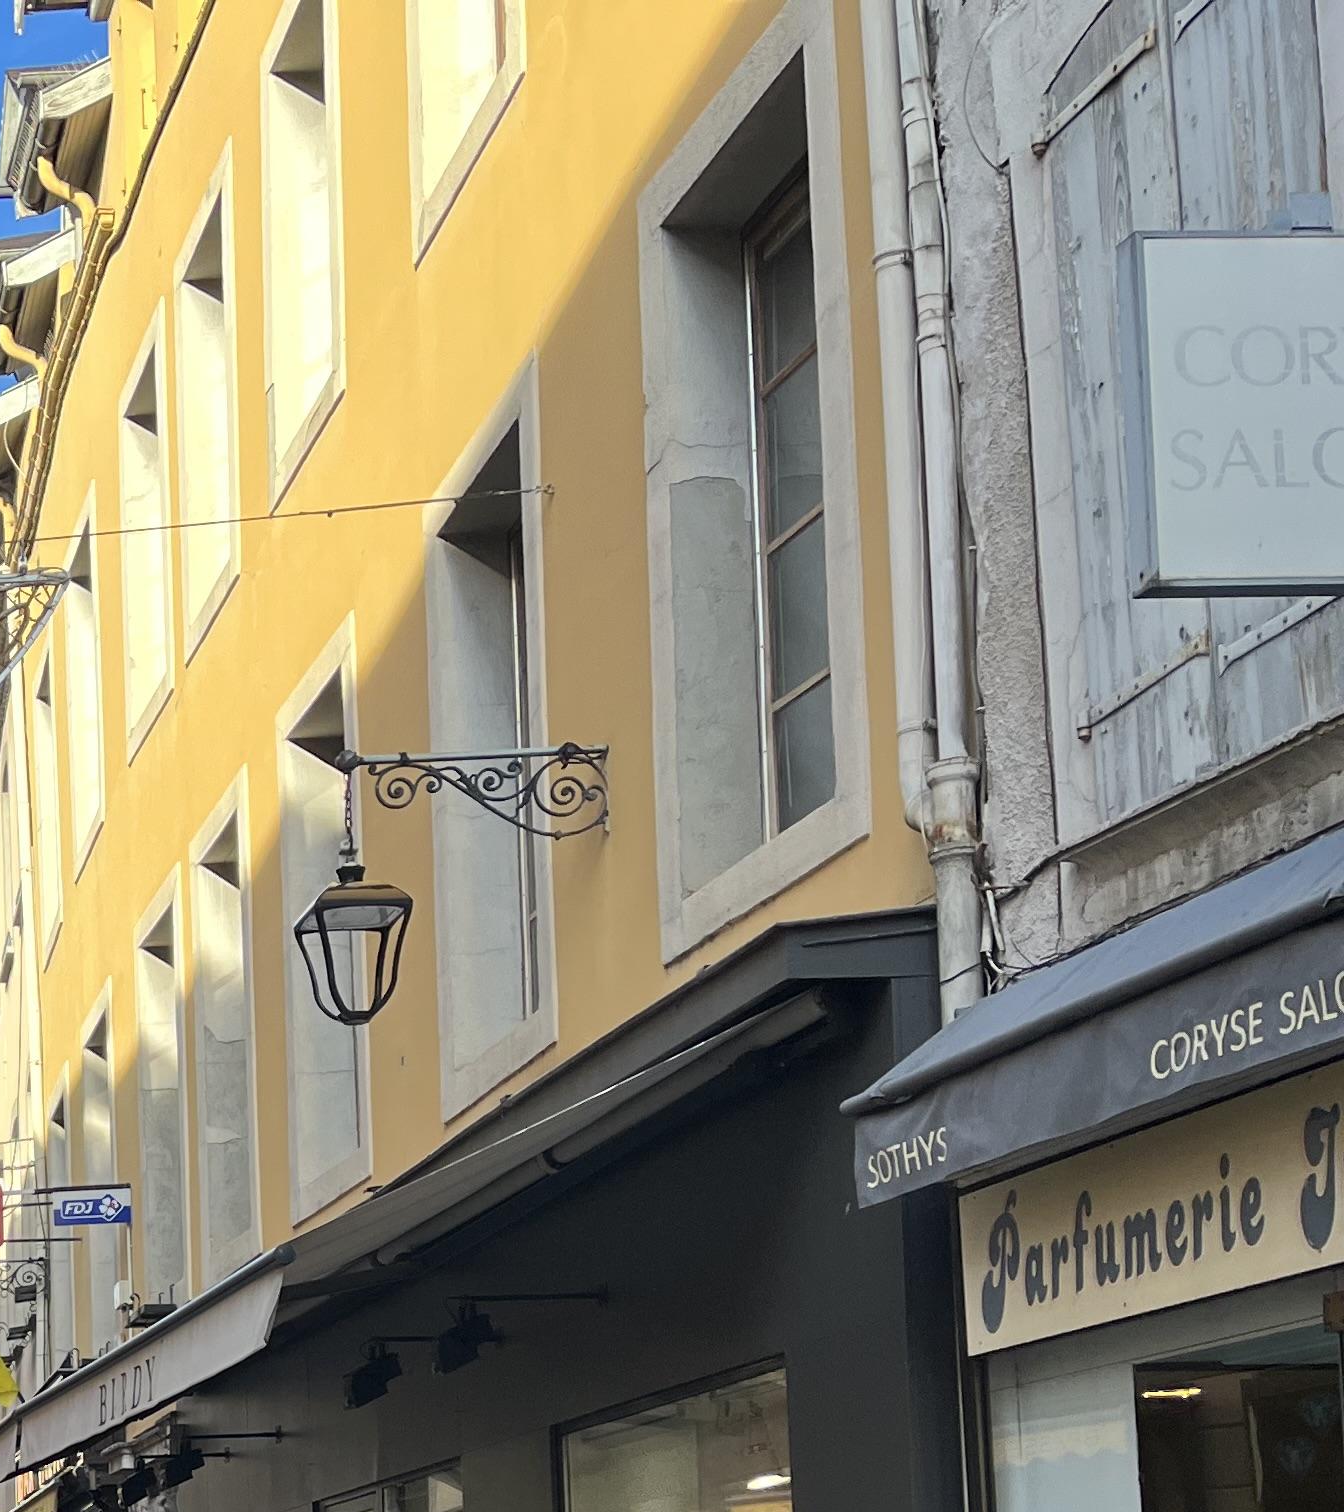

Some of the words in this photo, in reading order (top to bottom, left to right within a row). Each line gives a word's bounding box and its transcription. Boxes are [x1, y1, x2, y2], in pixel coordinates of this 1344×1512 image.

[1150, 1001, 1264, 1080] CORYSE
[866, 1126, 948, 1190] SOTHYS
[64, 1201, 94, 1216] FDJ
[980, 1152, 1266, 1334] Parfumerie
[98, 1356, 156, 1427] BIRDY
